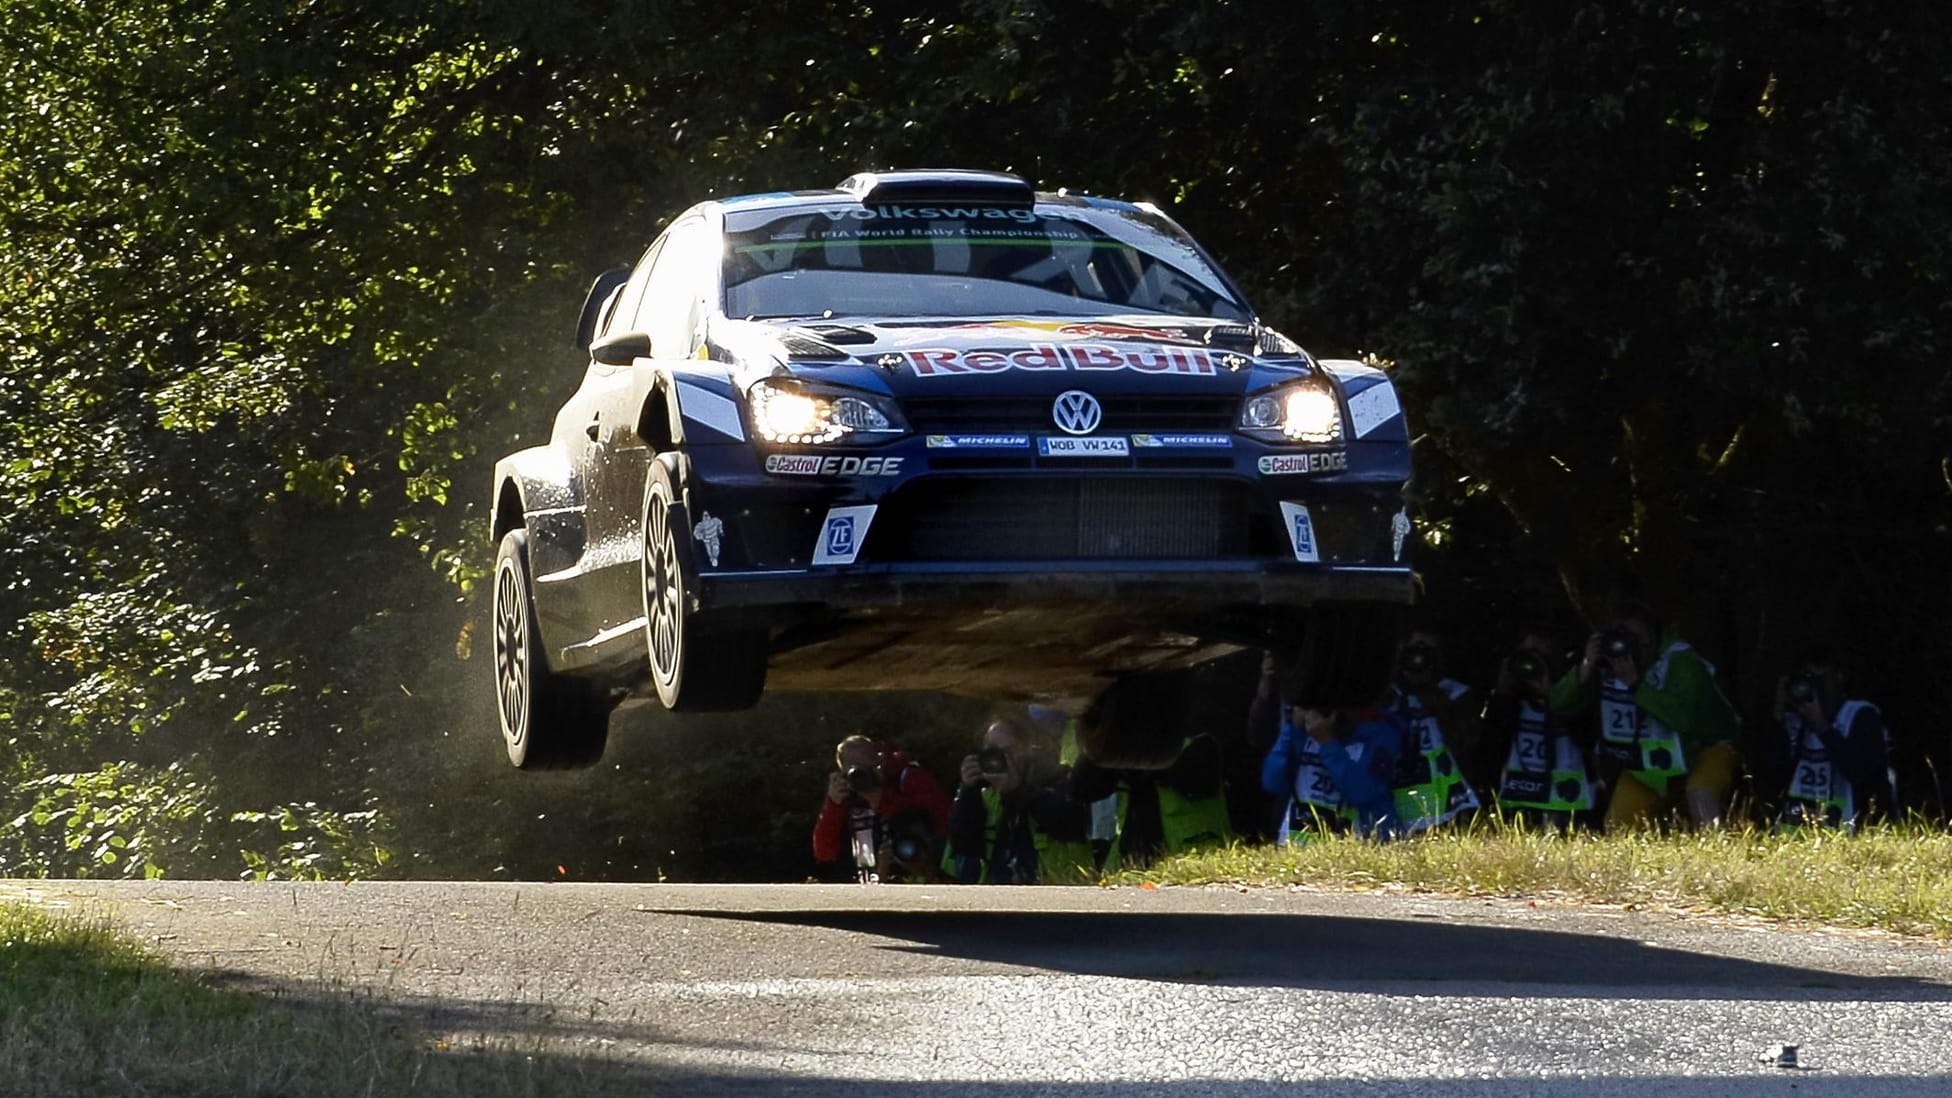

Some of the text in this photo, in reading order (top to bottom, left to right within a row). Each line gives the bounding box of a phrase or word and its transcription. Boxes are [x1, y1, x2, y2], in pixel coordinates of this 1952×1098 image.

[821, 228, 1079, 239] FIA World Rally Championship
[902, 344, 1215, 376] Red Bull
[957, 436, 1027, 445] MICHELIN
[1050, 439, 1075, 450] WOB
[1102, 440, 1126, 451] 141
[1162, 436, 1228, 445] MICHELIN
[777, 457, 904, 475] Castrol EDGE
[1272, 452, 1347, 472] Castrol EDGE
[1612, 709, 1634, 729] 21
